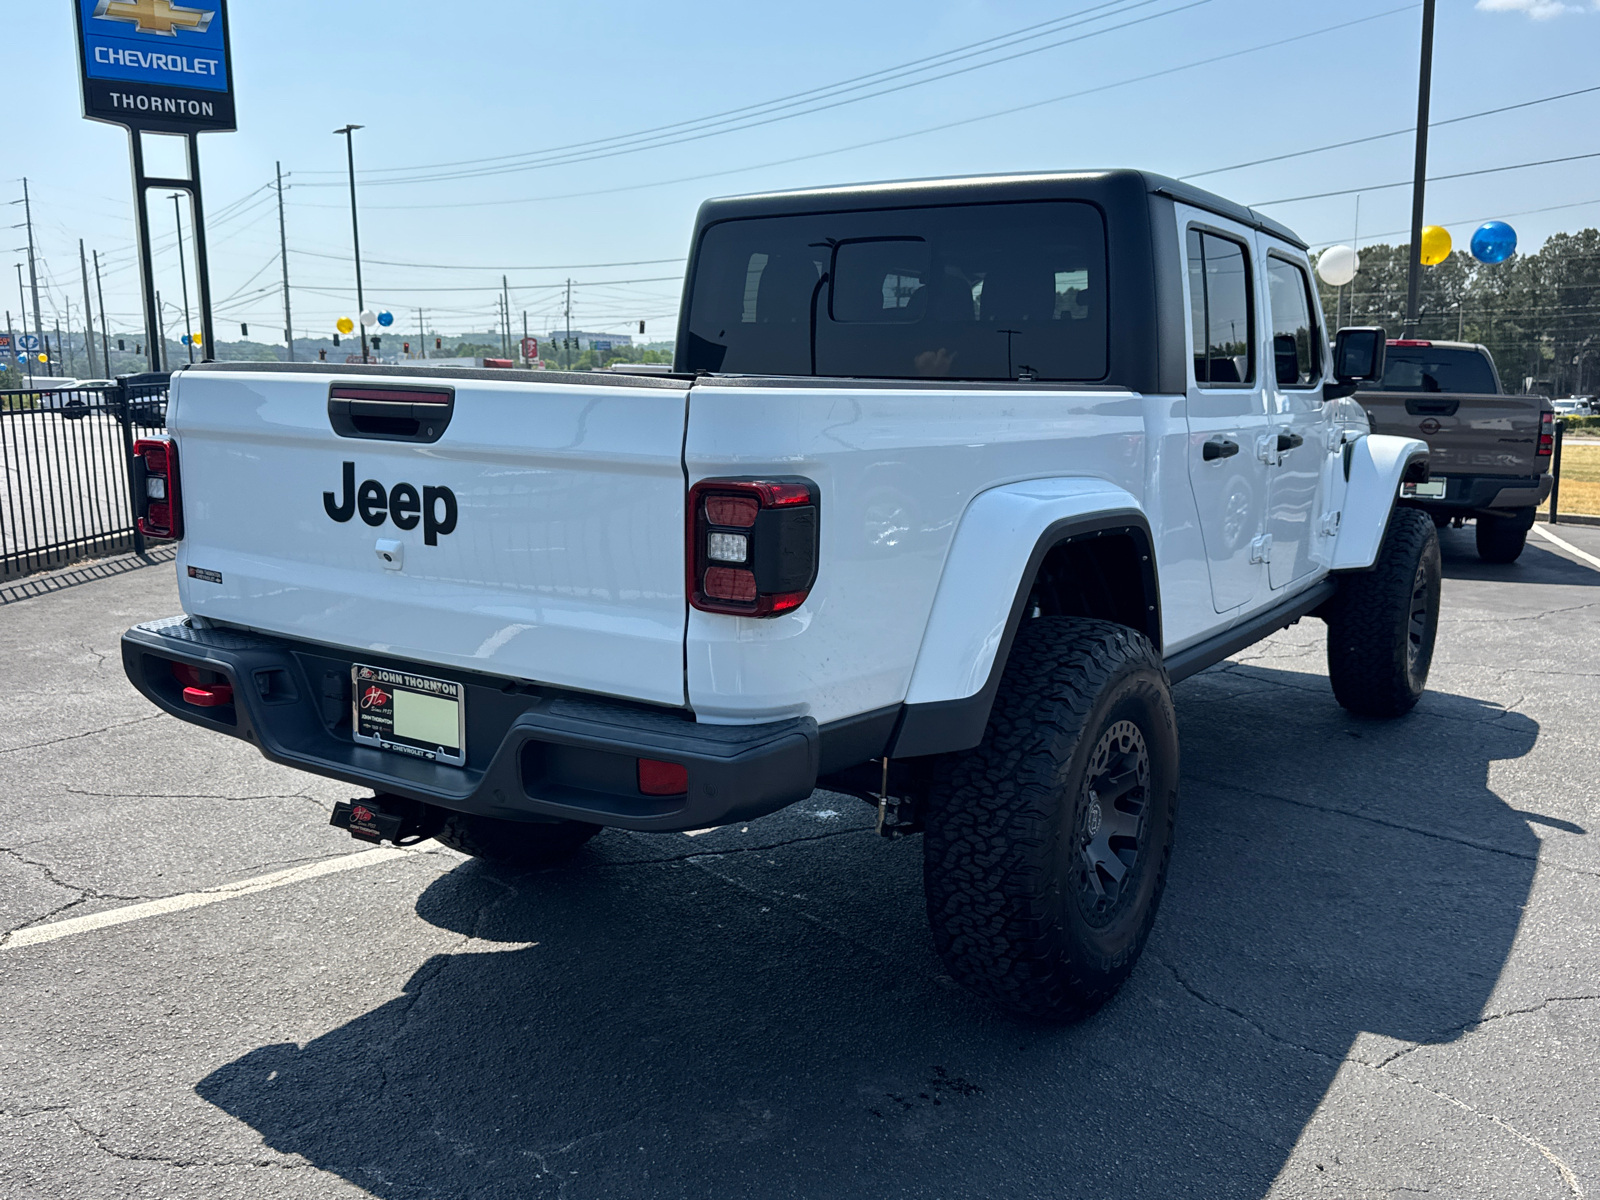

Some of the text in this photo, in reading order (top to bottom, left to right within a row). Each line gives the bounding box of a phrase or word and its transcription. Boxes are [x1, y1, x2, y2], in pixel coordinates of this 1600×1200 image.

[94, 46, 218, 76] CHEVROLET
[109, 92, 213, 116] THORNTON
[323, 461, 457, 546] Jeep
[378, 671, 403, 684] JOHN
[404, 675, 457, 695] THORNTON
[392, 745, 424, 757] CHEVROLET
